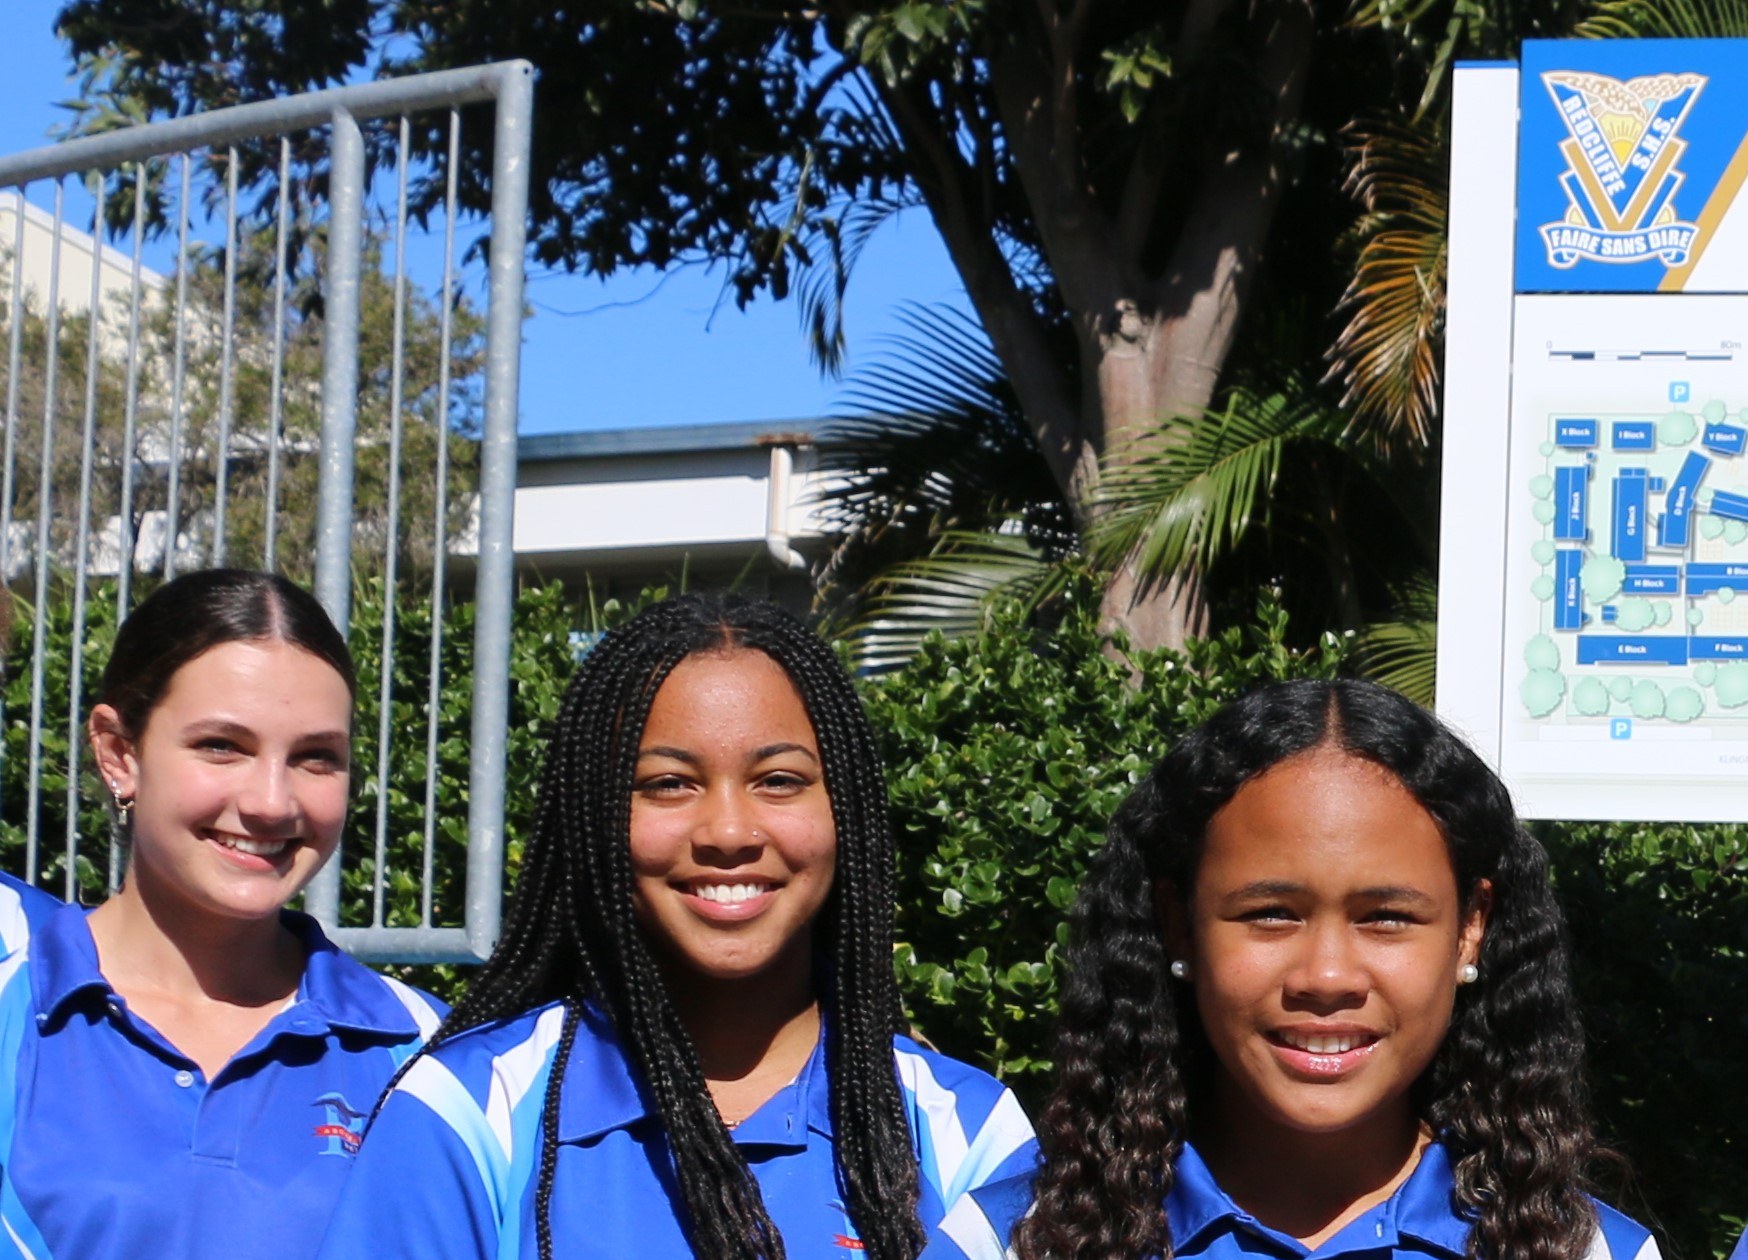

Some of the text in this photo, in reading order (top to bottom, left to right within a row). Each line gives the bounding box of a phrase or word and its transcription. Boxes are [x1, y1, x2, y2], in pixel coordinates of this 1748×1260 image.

[1561, 94, 1627, 197] REDCLIFFE
[1632, 116, 1676, 170] S.H.S.
[1549, 229, 1692, 256] FAIRE SANS DIRE
[1568, 427, 1591, 437] Block
[1624, 430, 1645, 440] Block
[1716, 432, 1738, 442] Block
[1571, 491, 1580, 513] Block
[1674, 485, 1687, 507] Block
[1626, 504, 1636, 526] Block
[1567, 576, 1576, 599] Block
[1642, 578, 1665, 588] Block
[1627, 644, 1647, 655] Block
[1720, 643, 1744, 653] Block
